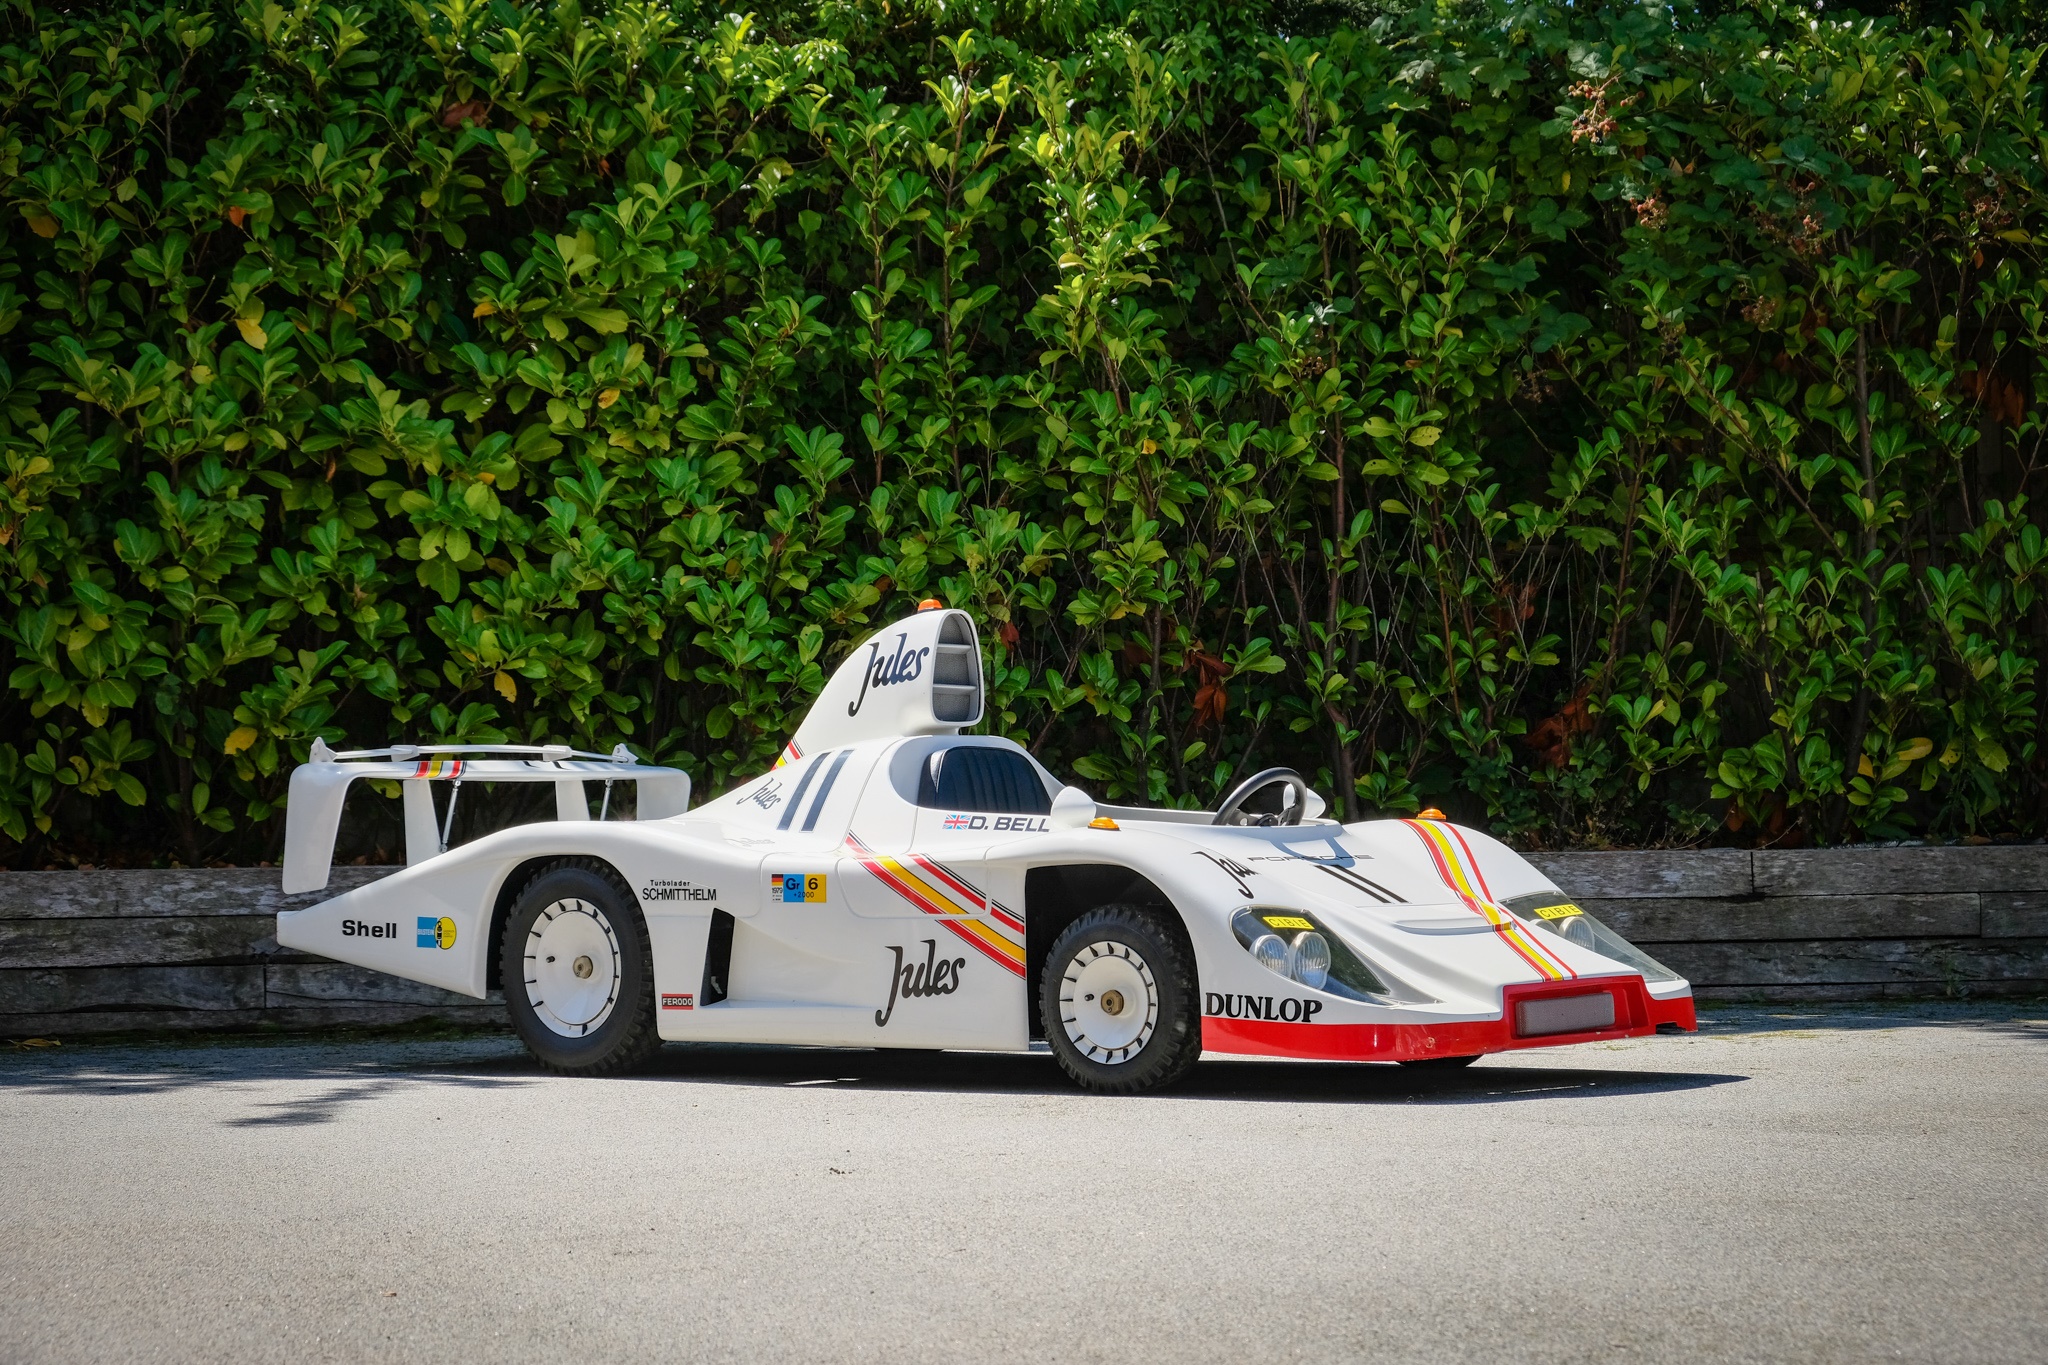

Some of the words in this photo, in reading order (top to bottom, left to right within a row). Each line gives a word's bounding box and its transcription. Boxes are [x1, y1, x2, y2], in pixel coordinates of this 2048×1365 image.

[848, 632, 930, 717] Jules
[736, 777, 783, 810] Jules
[968, 815, 989, 831] D.
[993, 816, 1050, 833] BELL
[650, 879, 691, 887] Turbolader
[785, 877, 800, 891] Gr
[808, 877, 818, 891] 6
[642, 887, 717, 901] SCHMITTHELM
[1539, 905, 1580, 918] CIBIE
[341, 919, 397, 939] Shell
[1268, 918, 1311, 928] CIBIE
[874, 938, 966, 1028] Jules
[662, 997, 693, 1006] FERODO
[1205, 992, 1323, 1023] DUNLOP
